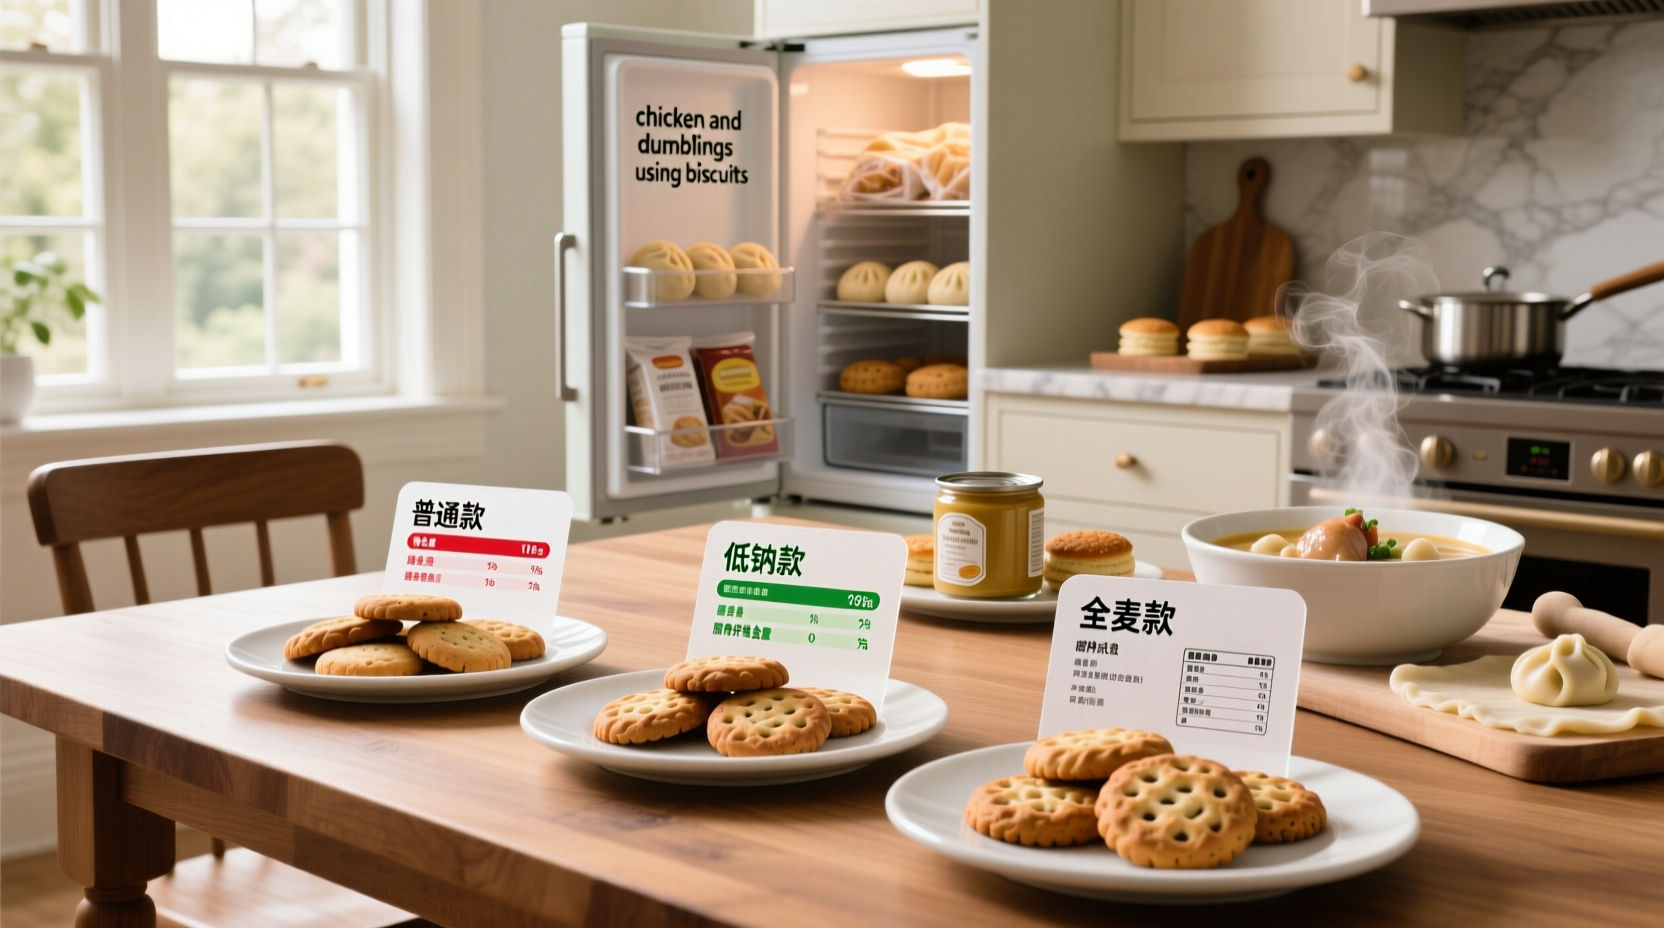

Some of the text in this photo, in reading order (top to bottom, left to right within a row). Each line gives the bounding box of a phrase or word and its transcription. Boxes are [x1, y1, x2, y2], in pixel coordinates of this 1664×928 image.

[636, 104, 742, 131] chicken and
[638, 132, 734, 162] dumblings
[635, 161, 749, 188] using biscuits
[412, 498, 486, 531] 普通款
[723, 541, 806, 577] 低钠款
[1079, 595, 1176, 637] 全麦款
